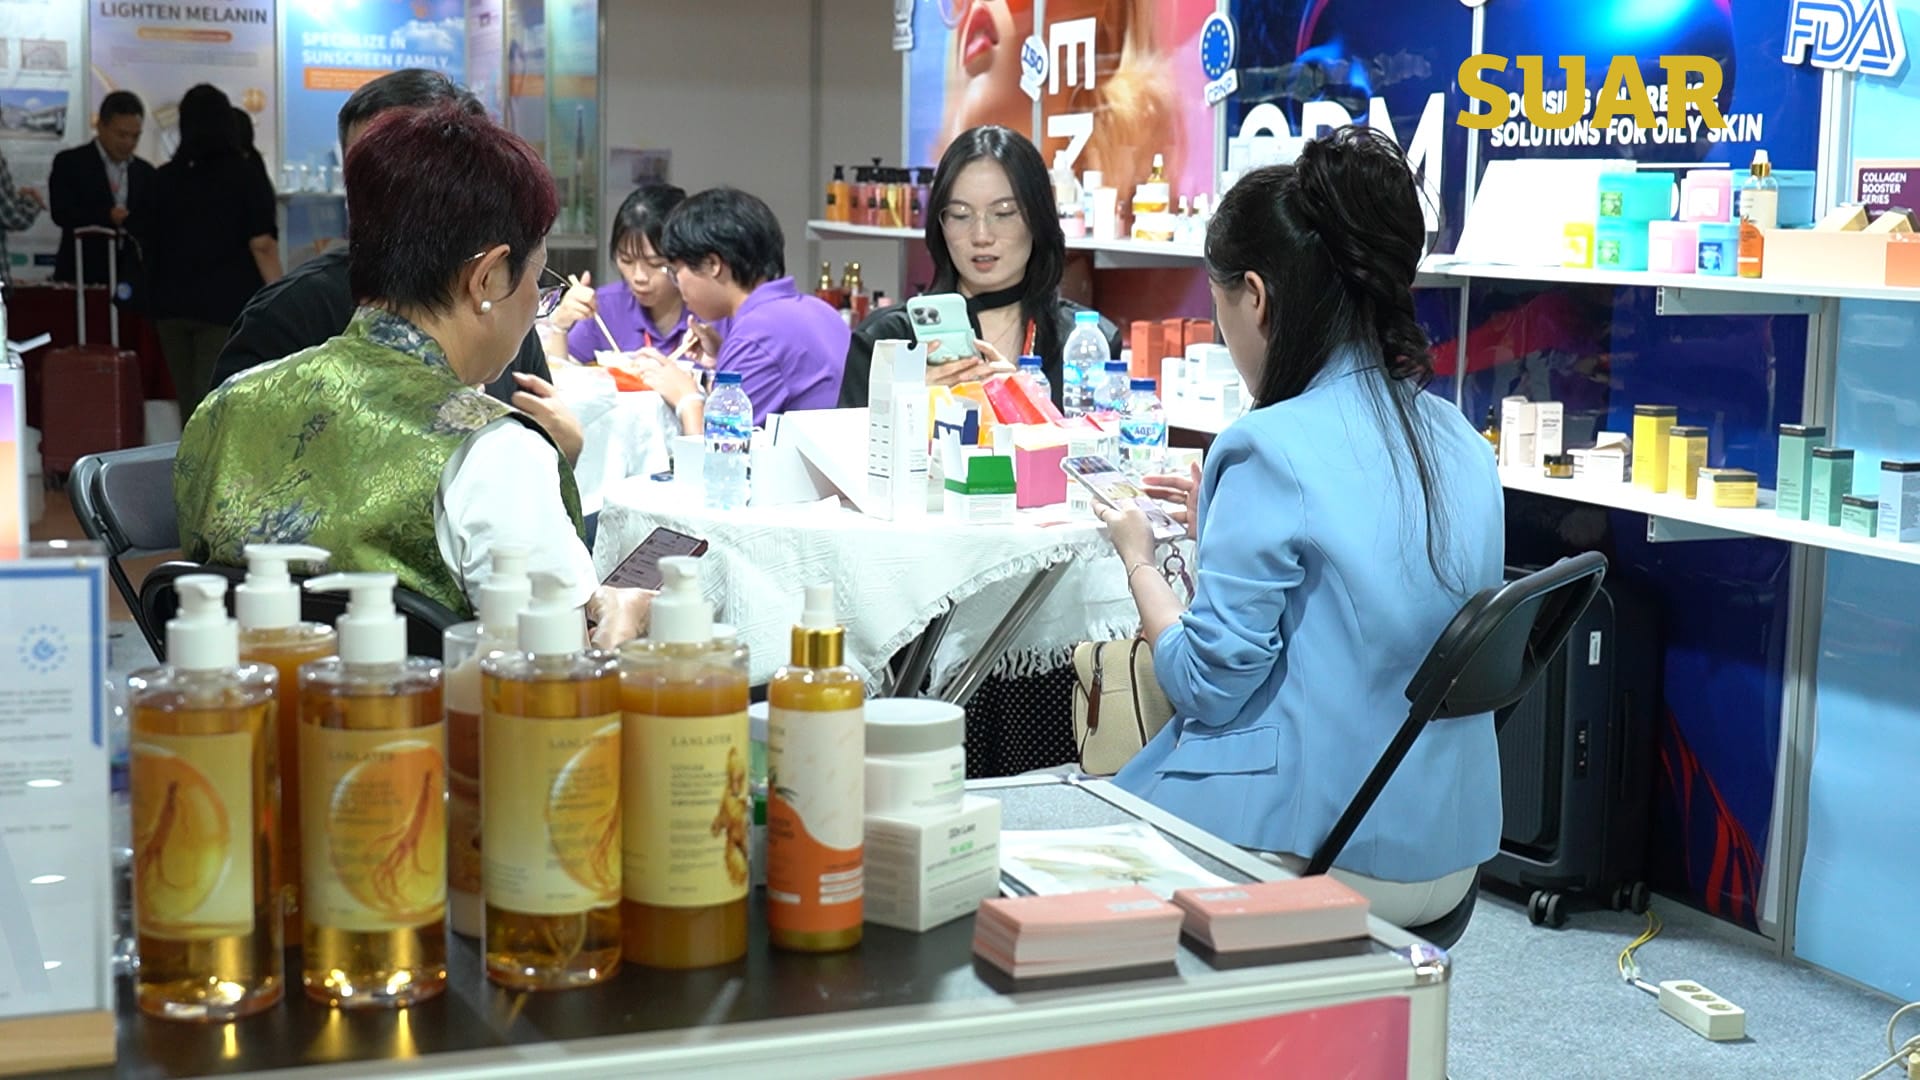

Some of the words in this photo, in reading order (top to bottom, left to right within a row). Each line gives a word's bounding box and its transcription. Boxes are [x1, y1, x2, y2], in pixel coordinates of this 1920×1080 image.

[101, 2, 180, 20] LIGHTEN
[186, 7, 267, 24] MELANIN
[302, 31, 386, 49] SPECIALIZE
[390, 33, 407, 49] IN
[1783, 0, 1896, 69] FDA
[302, 51, 393, 66] SUNSCREEN
[395, 54, 449, 68] FAMILY
[1023, 43, 1044, 75] ISO
[1490, 119, 1601, 147] SOLUTIONS
[1606, 117, 1647, 145] FOR
[1651, 115, 1702, 144] OILY
[1707, 113, 1764, 142] SKIN
[1862, 172, 1907, 183] COLLAGEN
[1862, 183, 1902, 194] BOOSTER
[1861, 194, 1890, 205] SERIES
